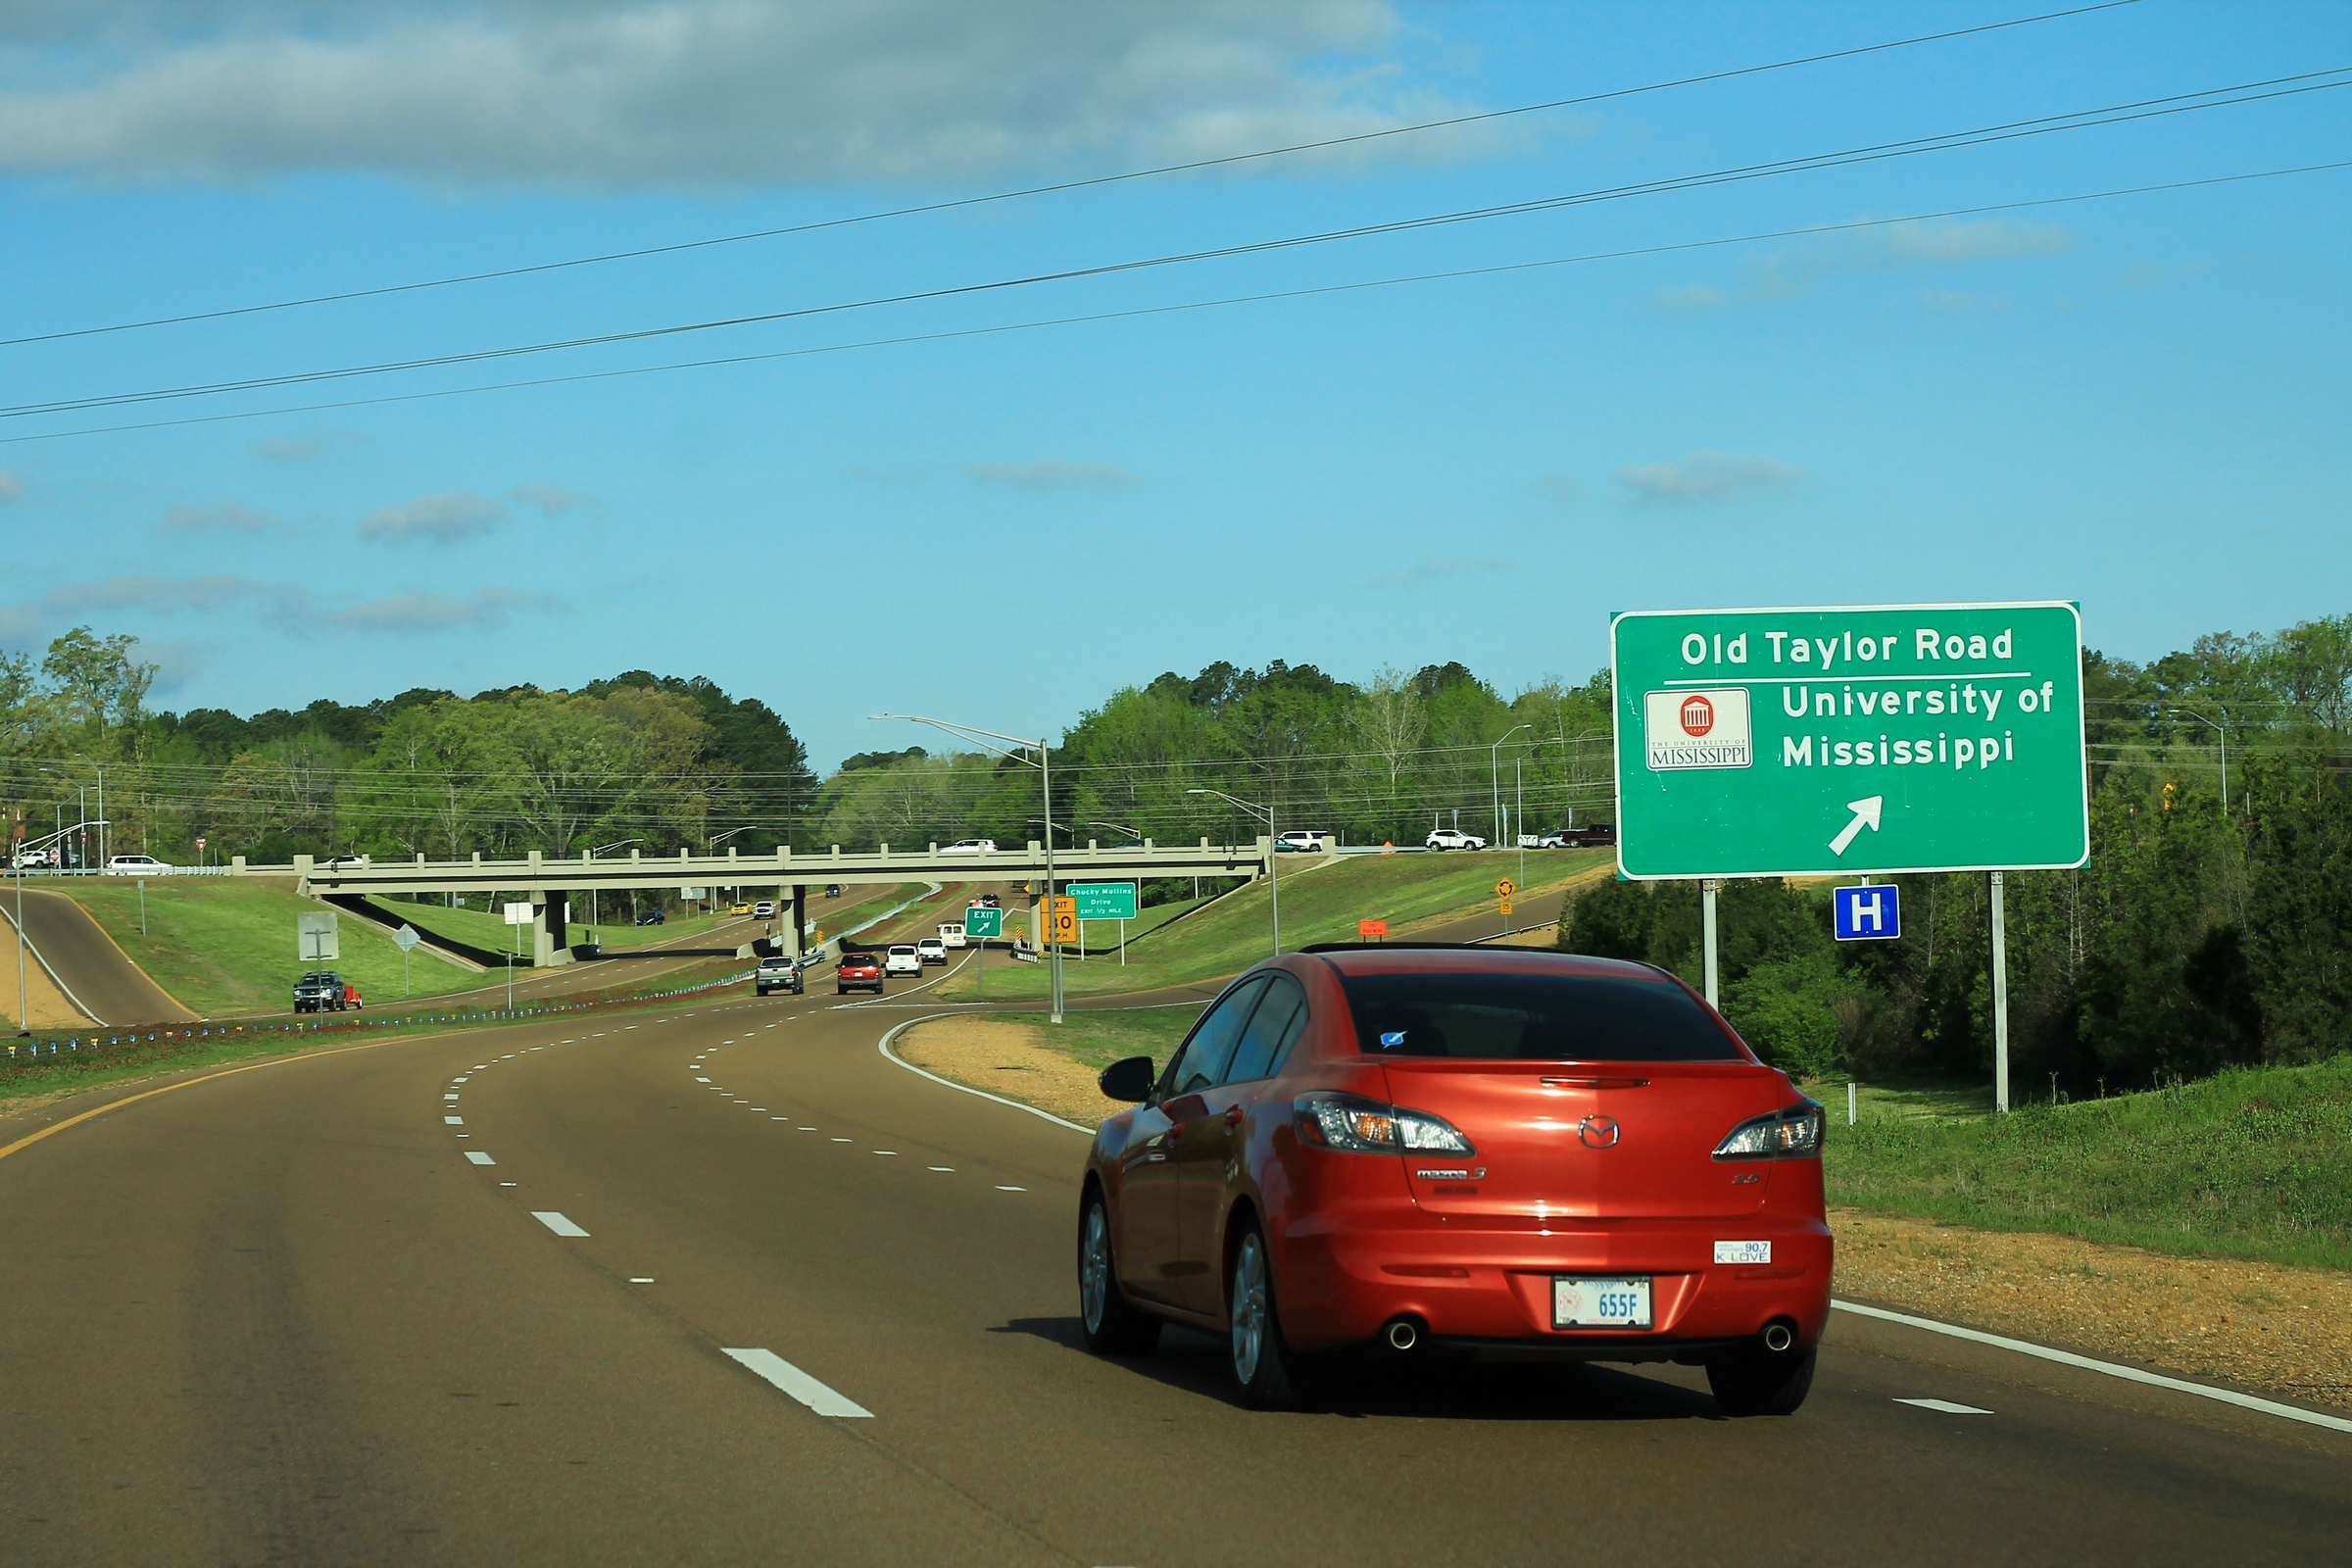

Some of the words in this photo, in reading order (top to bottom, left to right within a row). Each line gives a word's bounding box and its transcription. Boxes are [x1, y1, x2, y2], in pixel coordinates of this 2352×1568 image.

[1681, 632, 1747, 665] Old
[1765, 630, 1898, 670] Taylor
[1915, 628, 2012, 660] Road
[1783, 683, 2003, 721] University
[2019, 681, 2054, 713] of
[1652, 747, 1746, 765] MISSISSIPPI
[1783, 730, 2013, 770] Mississippi
[1851, 893, 1883, 932] H
[1716, 1252, 1725, 1262] K
[1731, 1252, 1768, 1262] LOVE
[1745, 1243, 1768, 1252] 90.7
[1599, 1294, 1637, 1317] 655F
